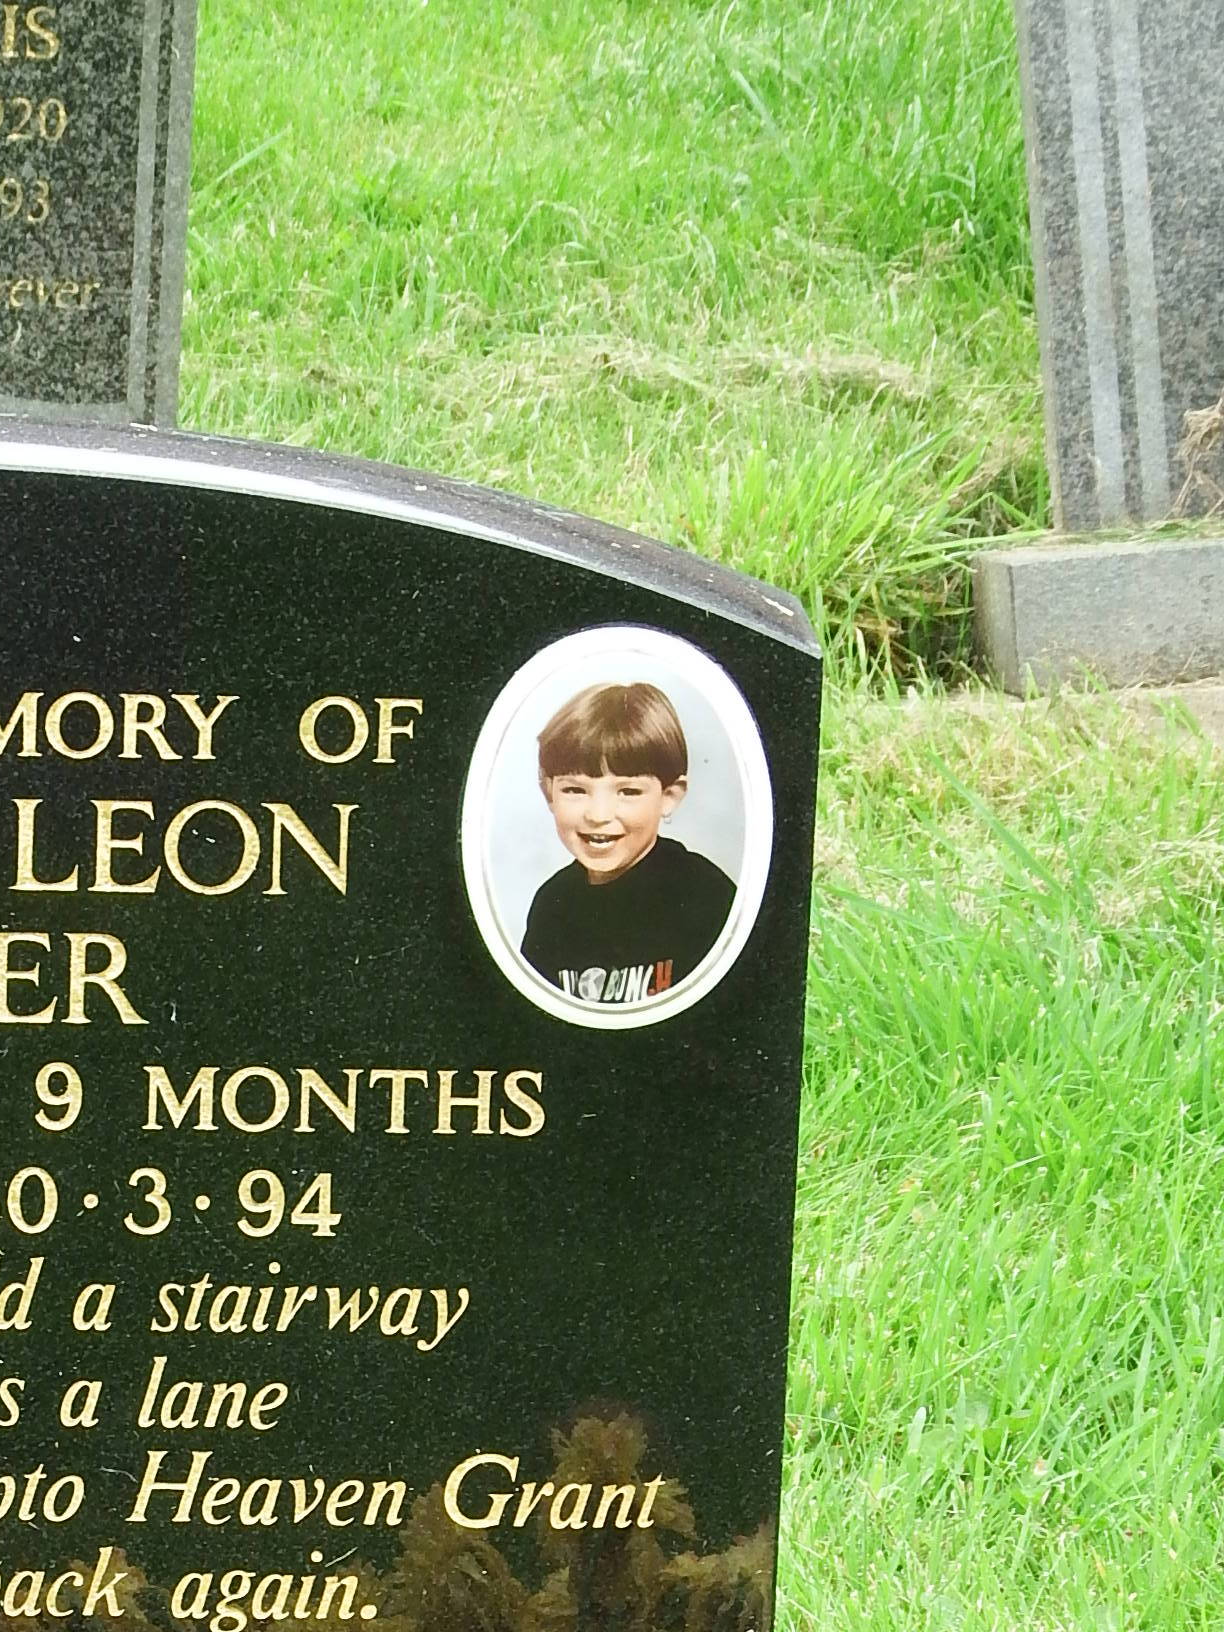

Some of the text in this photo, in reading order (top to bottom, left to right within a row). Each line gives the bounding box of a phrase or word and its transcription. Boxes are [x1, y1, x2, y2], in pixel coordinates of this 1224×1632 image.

[298, 696, 424, 765] OF
[8, 797, 360, 896] LEON
[34, 1061, 83, 1131] 9
[141, 1065, 547, 1137] MONTHS
[72, 1283, 116, 1332] a
[150, 1261, 470, 1352] stairway
[59, 1380, 103, 1428] a
[137, 1355, 289, 1431] lane
[124, 1450, 407, 1527] Heaven
[443, 1453, 669, 1533] Grant
